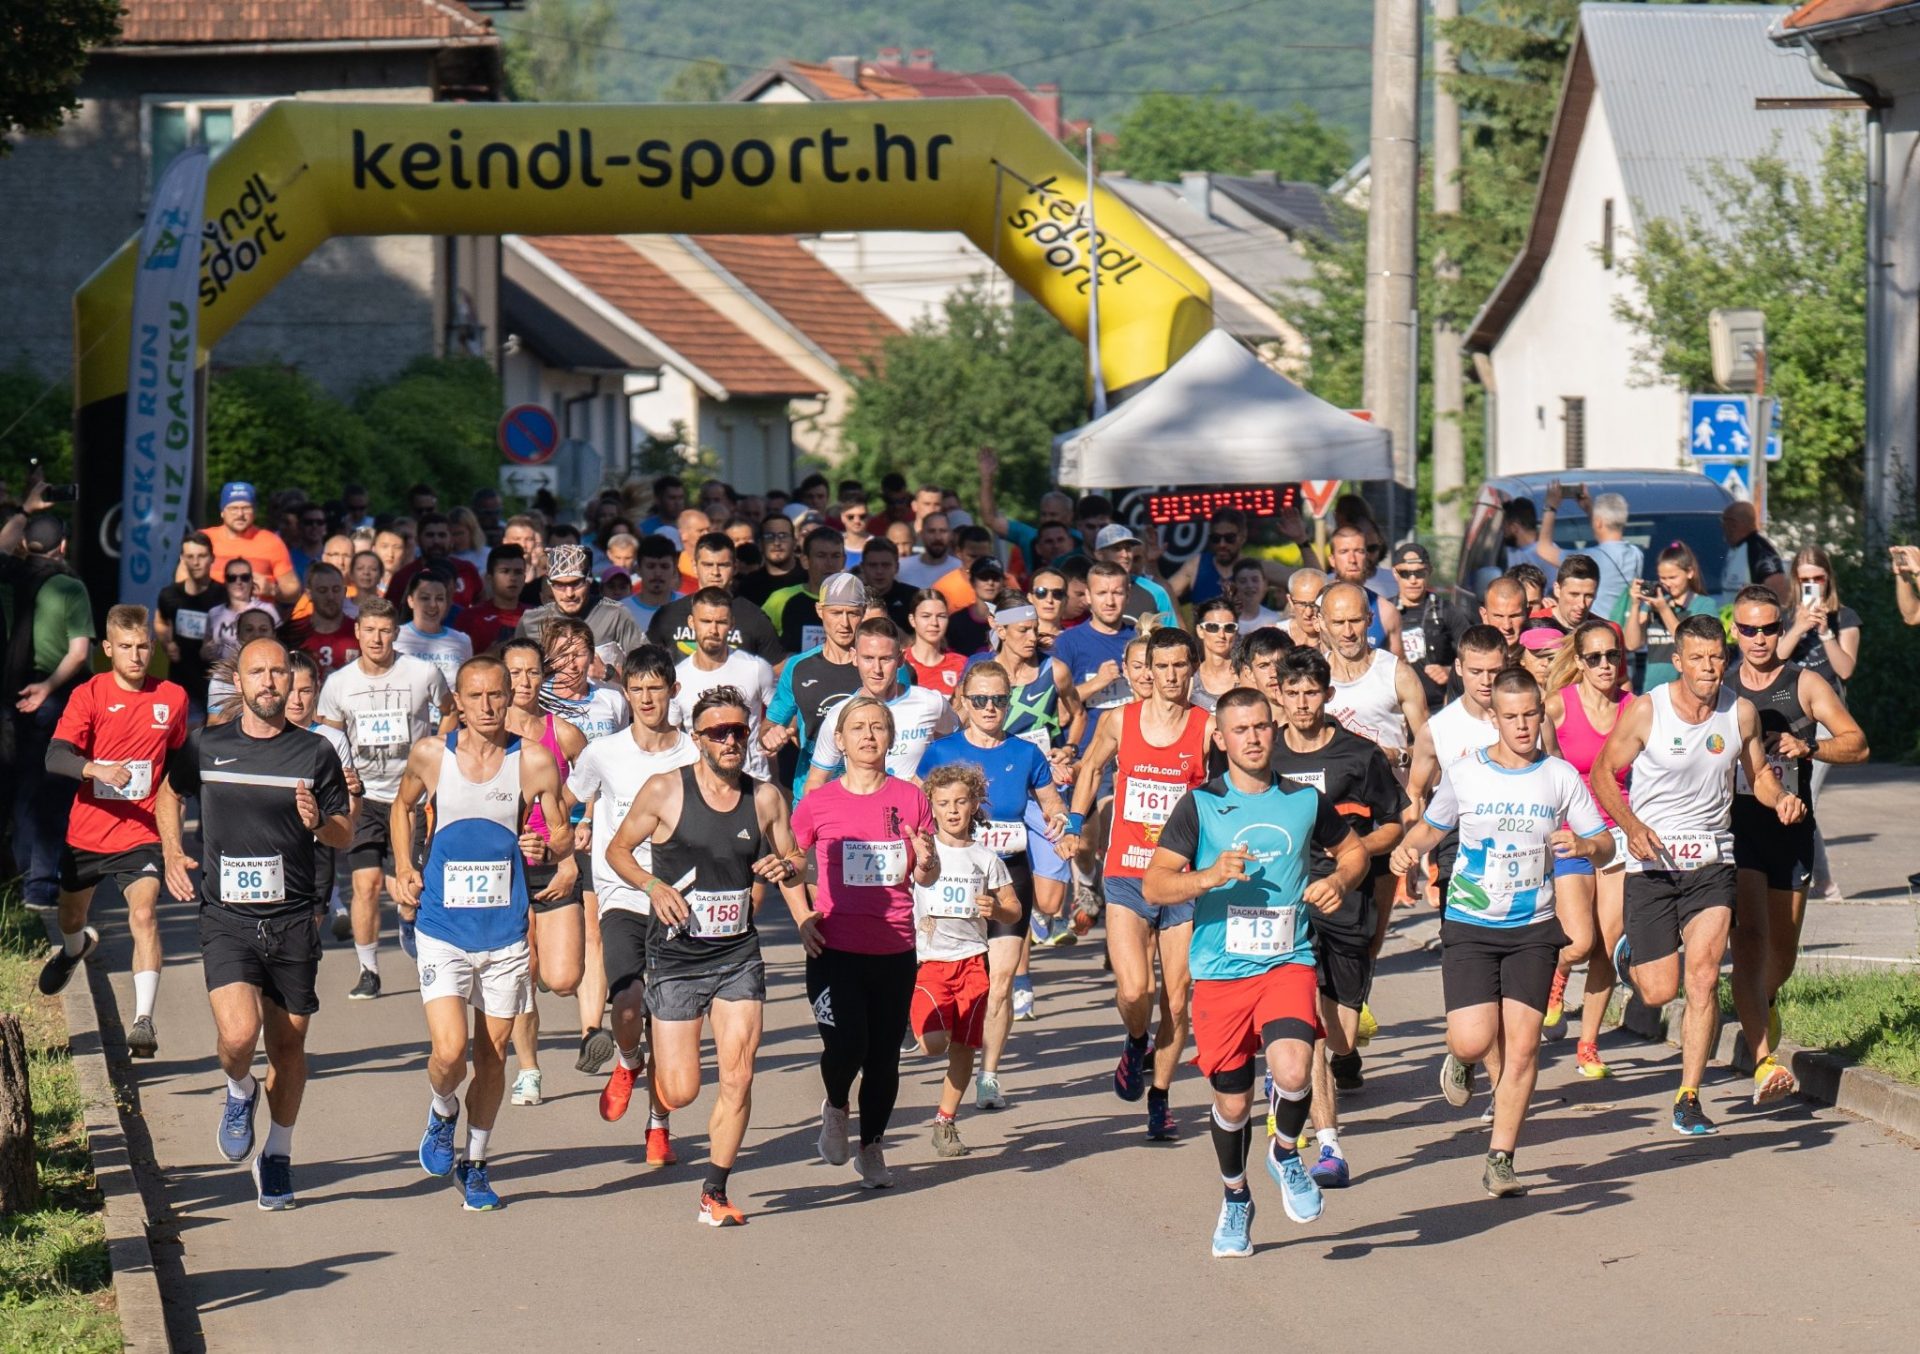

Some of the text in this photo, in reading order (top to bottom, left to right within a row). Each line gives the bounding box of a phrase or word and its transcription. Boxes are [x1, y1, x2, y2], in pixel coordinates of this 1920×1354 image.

[353, 123, 953, 200] keindl-sport.hr
[199, 213, 286, 308] sport
[1007, 208, 1104, 295] sport
[164, 300, 190, 451] GACKU
[130, 324, 160, 585] GACKA RUN
[371, 720, 390, 733] 44
[902, 728, 928, 741] RUN
[891, 743, 908, 756] 22
[1134, 763, 1182, 776] utrka.com
[1137, 791, 1169, 811] 161
[1475, 802, 1556, 820] GACKA RUN
[1497, 817, 1535, 833] 2022
[981, 831, 1011, 848] 117
[1668, 843, 1702, 859] 142
[474, 864, 490, 872] RUN
[862, 852, 887, 871] 73
[1508, 860, 1519, 878] 9
[237, 870, 262, 889] 86
[465, 875, 489, 893] 12
[943, 886, 966, 903] 90
[706, 904, 740, 922] 158
[1249, 919, 1273, 938] 13
